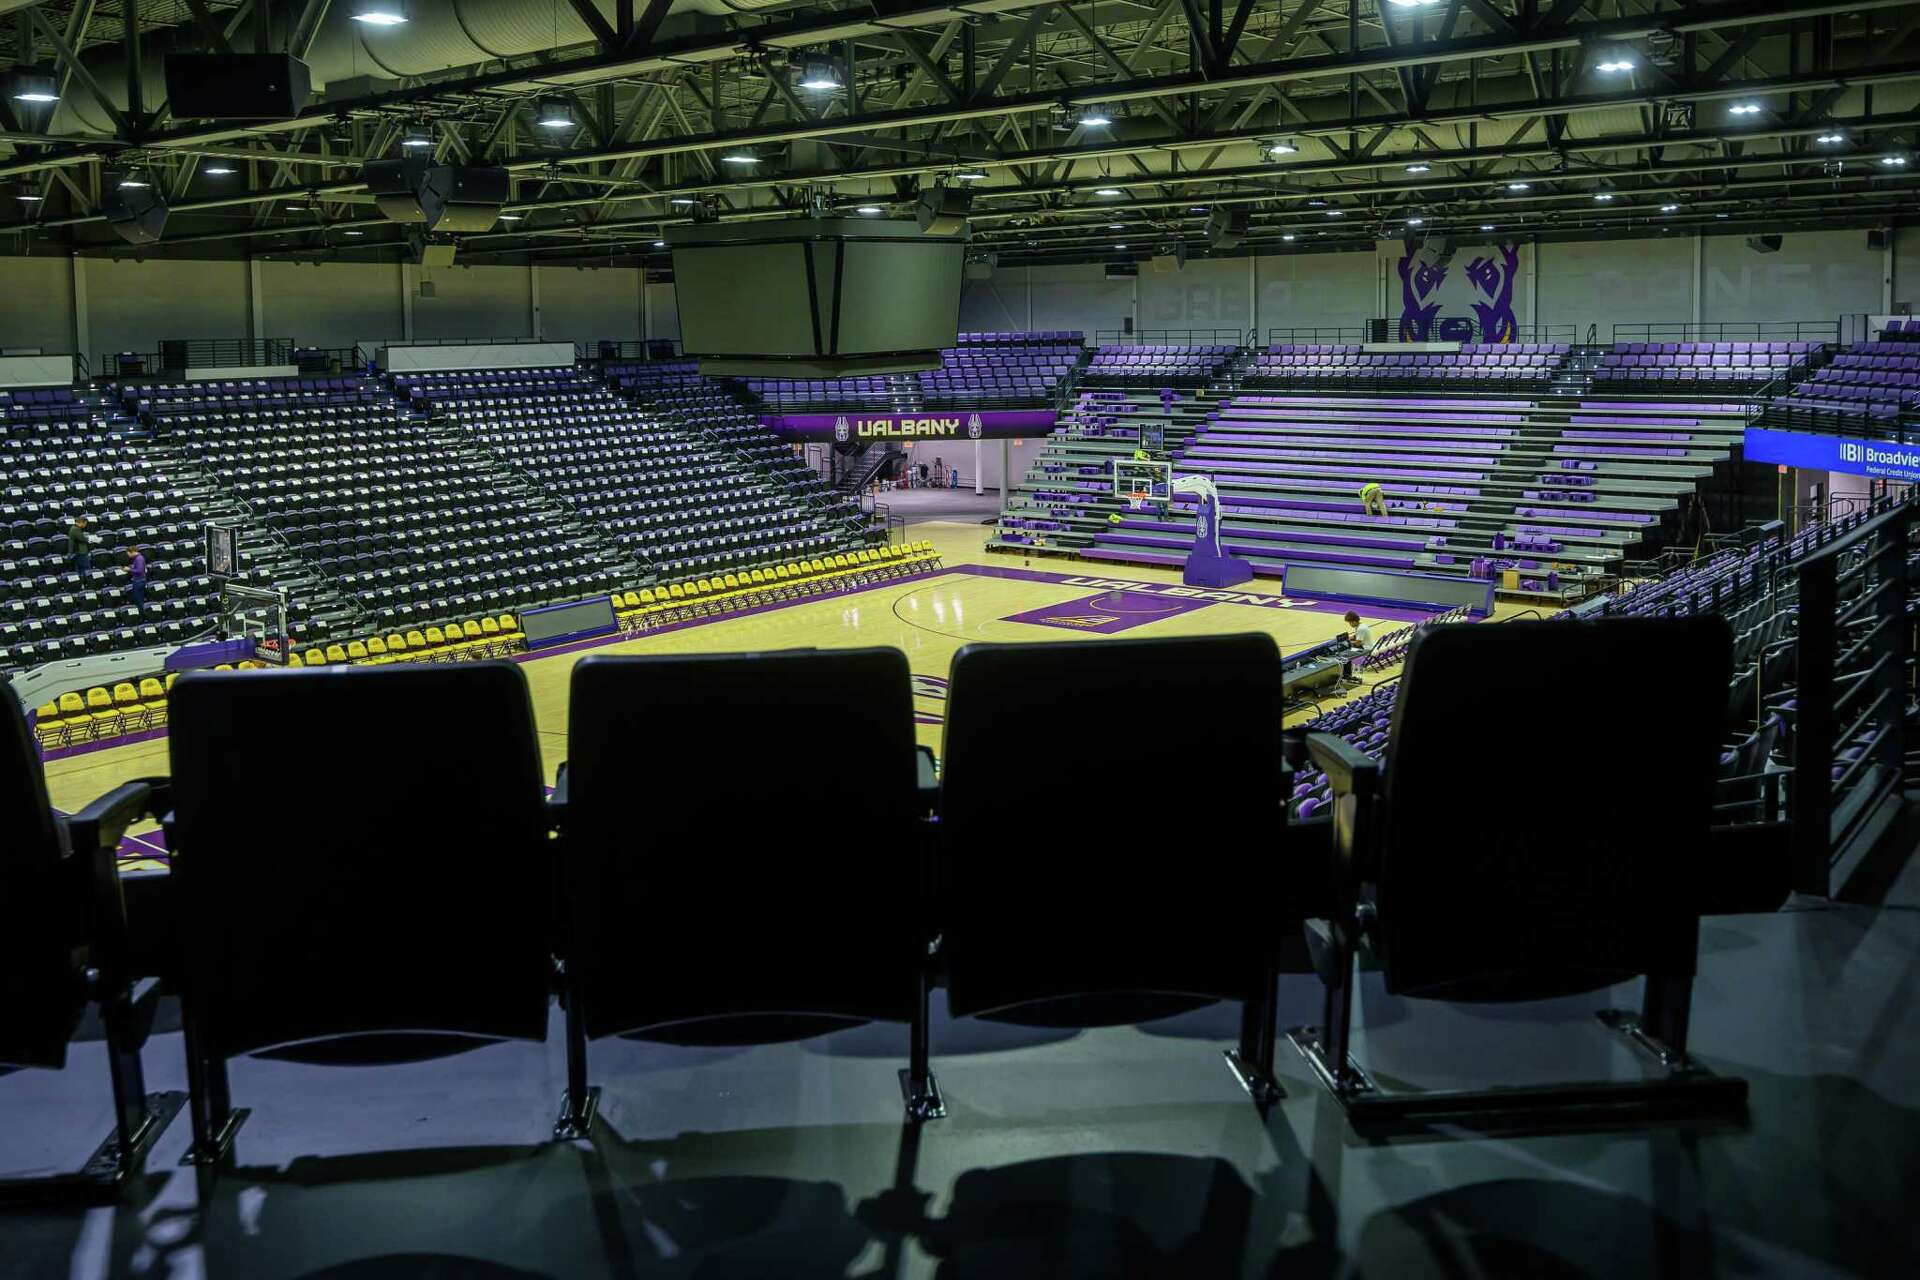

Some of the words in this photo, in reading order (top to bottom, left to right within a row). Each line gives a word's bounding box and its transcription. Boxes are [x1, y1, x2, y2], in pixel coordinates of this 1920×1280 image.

[857, 418, 960, 436] UALBANY
[1866, 447, 1920, 467] Broadvie
[1866, 465, 1886, 474] Federal
[1886, 468, 1903, 477] Credit
[1060, 577, 1319, 608] UALBANY
